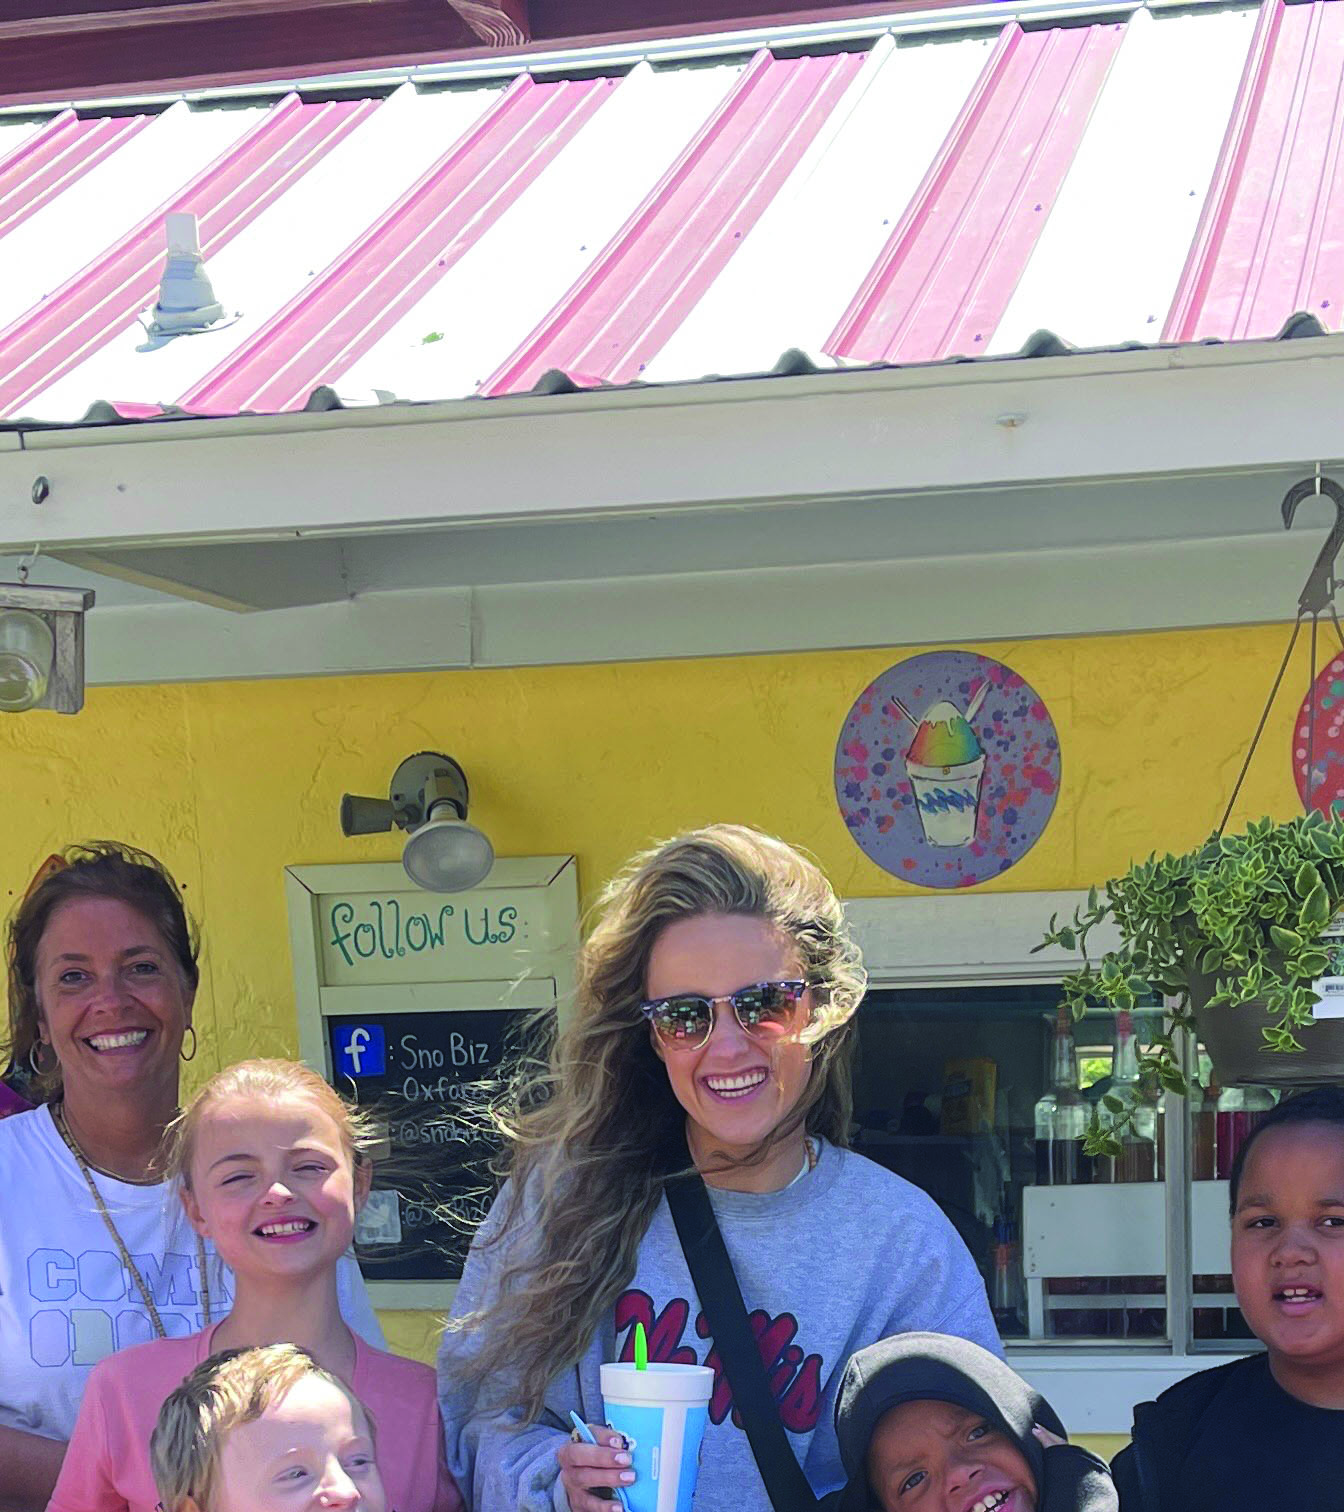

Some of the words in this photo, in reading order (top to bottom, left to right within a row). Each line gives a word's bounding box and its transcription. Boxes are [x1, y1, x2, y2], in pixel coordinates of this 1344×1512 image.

[331, 900, 454, 966] follow
[400, 1034, 444, 1071] Sno
[450, 1032, 490, 1066] Biz
